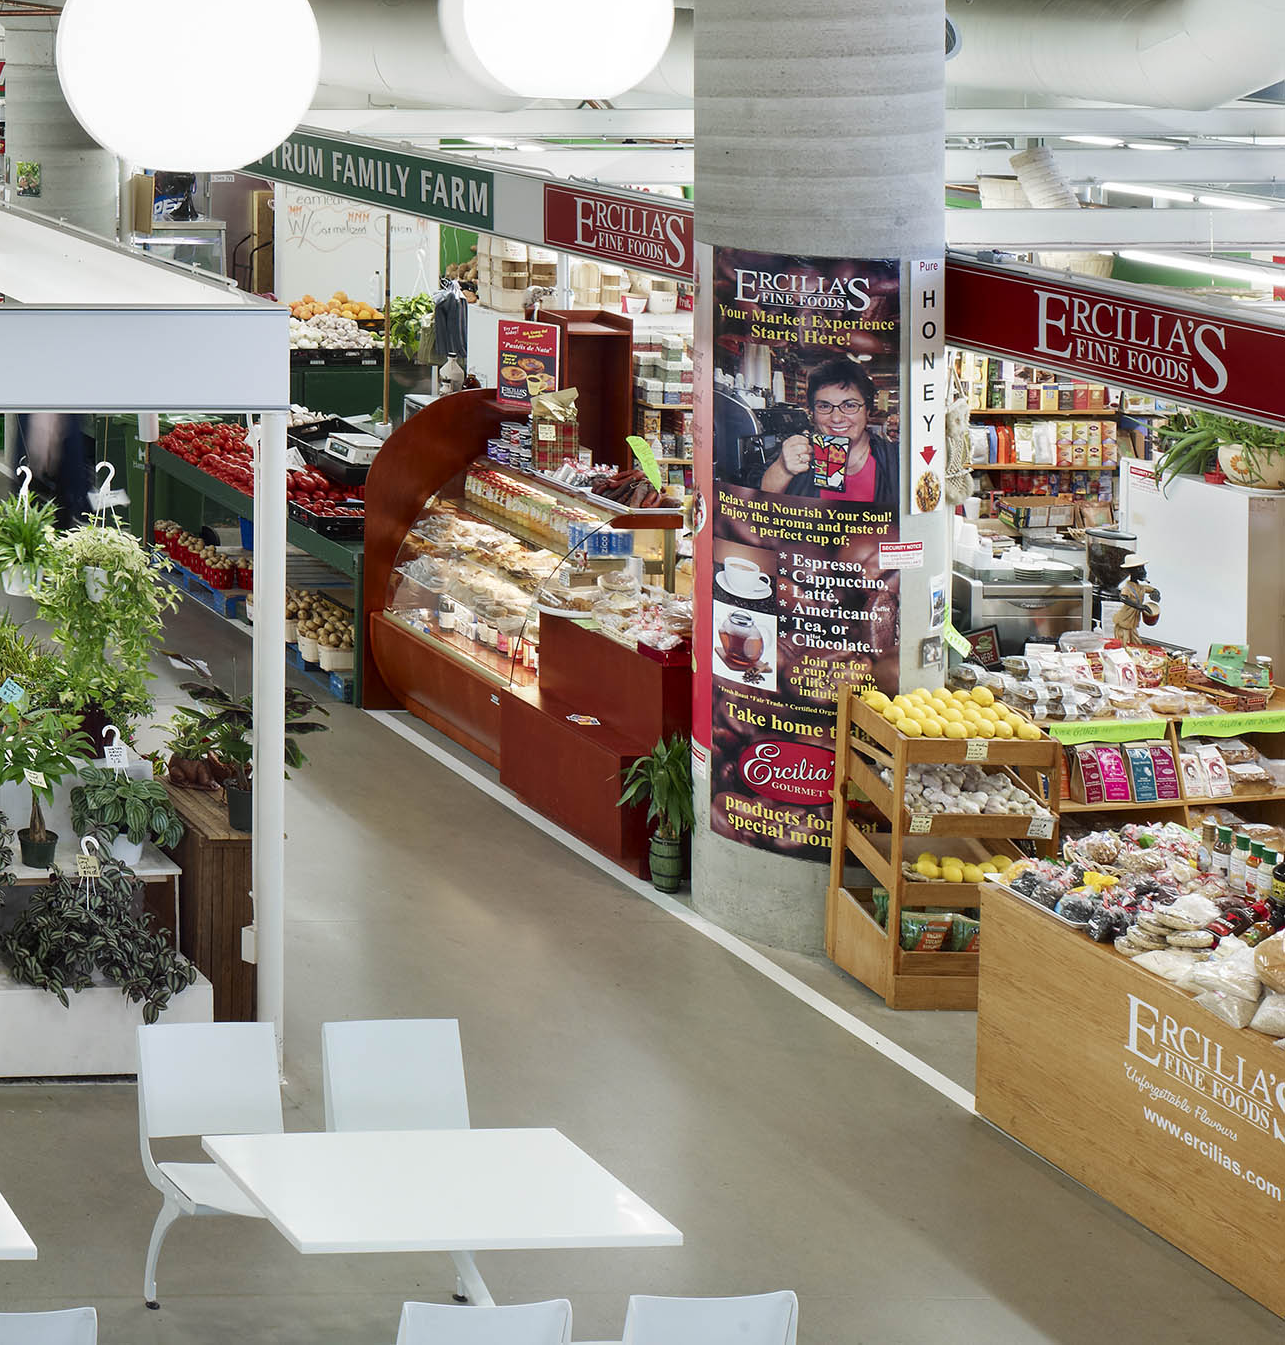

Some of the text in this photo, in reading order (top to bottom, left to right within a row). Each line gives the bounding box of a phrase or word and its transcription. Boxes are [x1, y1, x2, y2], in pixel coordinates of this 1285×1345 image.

[331, 152, 488, 217] FAMILY FARM
[574, 197, 685, 267] ERCILIA'S
[598, 234, 664, 262] FINE FOODS
[919, 261, 939, 271] Pure
[733, 268, 871, 311] ERCILIA'S
[761, 292, 846, 309] FINE FOODS
[718, 304, 896, 332] Your Market Experience
[751, 324, 852, 346] Starts Here!
[1033, 289, 1229, 395] ERCILIA'S
[922, 290, 937, 432] HONEY
[1075, 338, 1190, 384] FINE FOODS
[719, 491, 892, 522] Relax and Nourish Your Soul!
[720, 504, 889, 535] Enjoy the aroma and taste of
[750, 524, 851, 547] a perfect cup of;
[881, 543, 924, 552] SECURITY NOTICE
[792, 553, 868, 574] Espresso,
[791, 569, 890, 591] Cappuccino,
[791, 585, 840, 605] Latté,
[791, 601, 883, 623] Americano,
[791, 616, 850, 635] Tea, or
[791, 633, 884, 654] Chocolate...
[793, 666, 876, 683] a cup, or two,
[801, 655, 868, 672] Join us for
[790, 675, 836, 691] of life's
[725, 702, 824, 739] Take home
[766, 699, 784, 709] Trade
[790, 703, 818, 715] Certified
[744, 743, 835, 786] Ercilia'
[771, 781, 825, 798] GOURMET
[725, 795, 833, 832] products for
[727, 811, 784, 839] special
[1164, 1051, 1270, 1130] FINE FOODS
[1194, 1105, 1238, 1142] Flavours
[1143, 1105, 1282, 1202] www.ercilias.com
